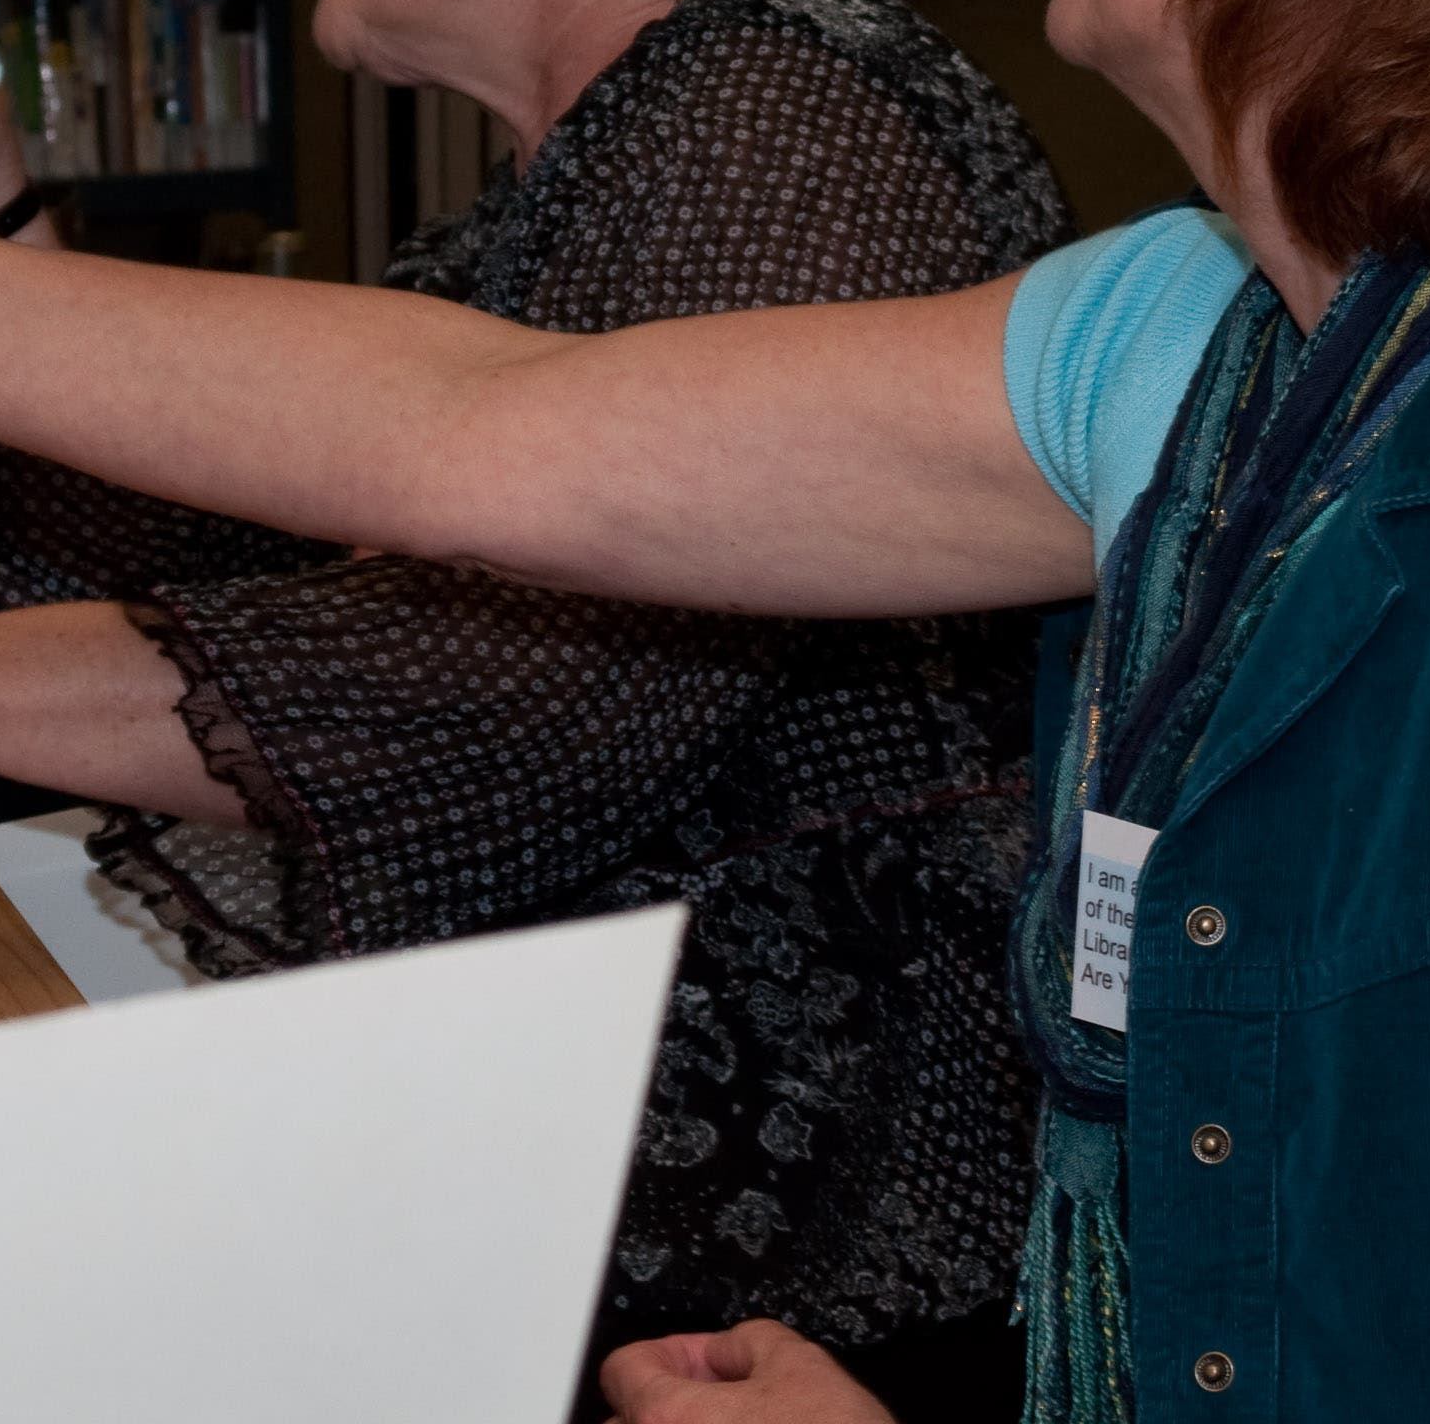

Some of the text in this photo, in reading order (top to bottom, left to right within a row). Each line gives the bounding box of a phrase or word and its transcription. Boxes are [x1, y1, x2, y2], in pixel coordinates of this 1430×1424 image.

[1087, 862, 1093, 883] I
[1099, 871, 1125, 893] am
[1085, 900, 1135, 929] of the
[1081, 962, 1113, 990] Are
